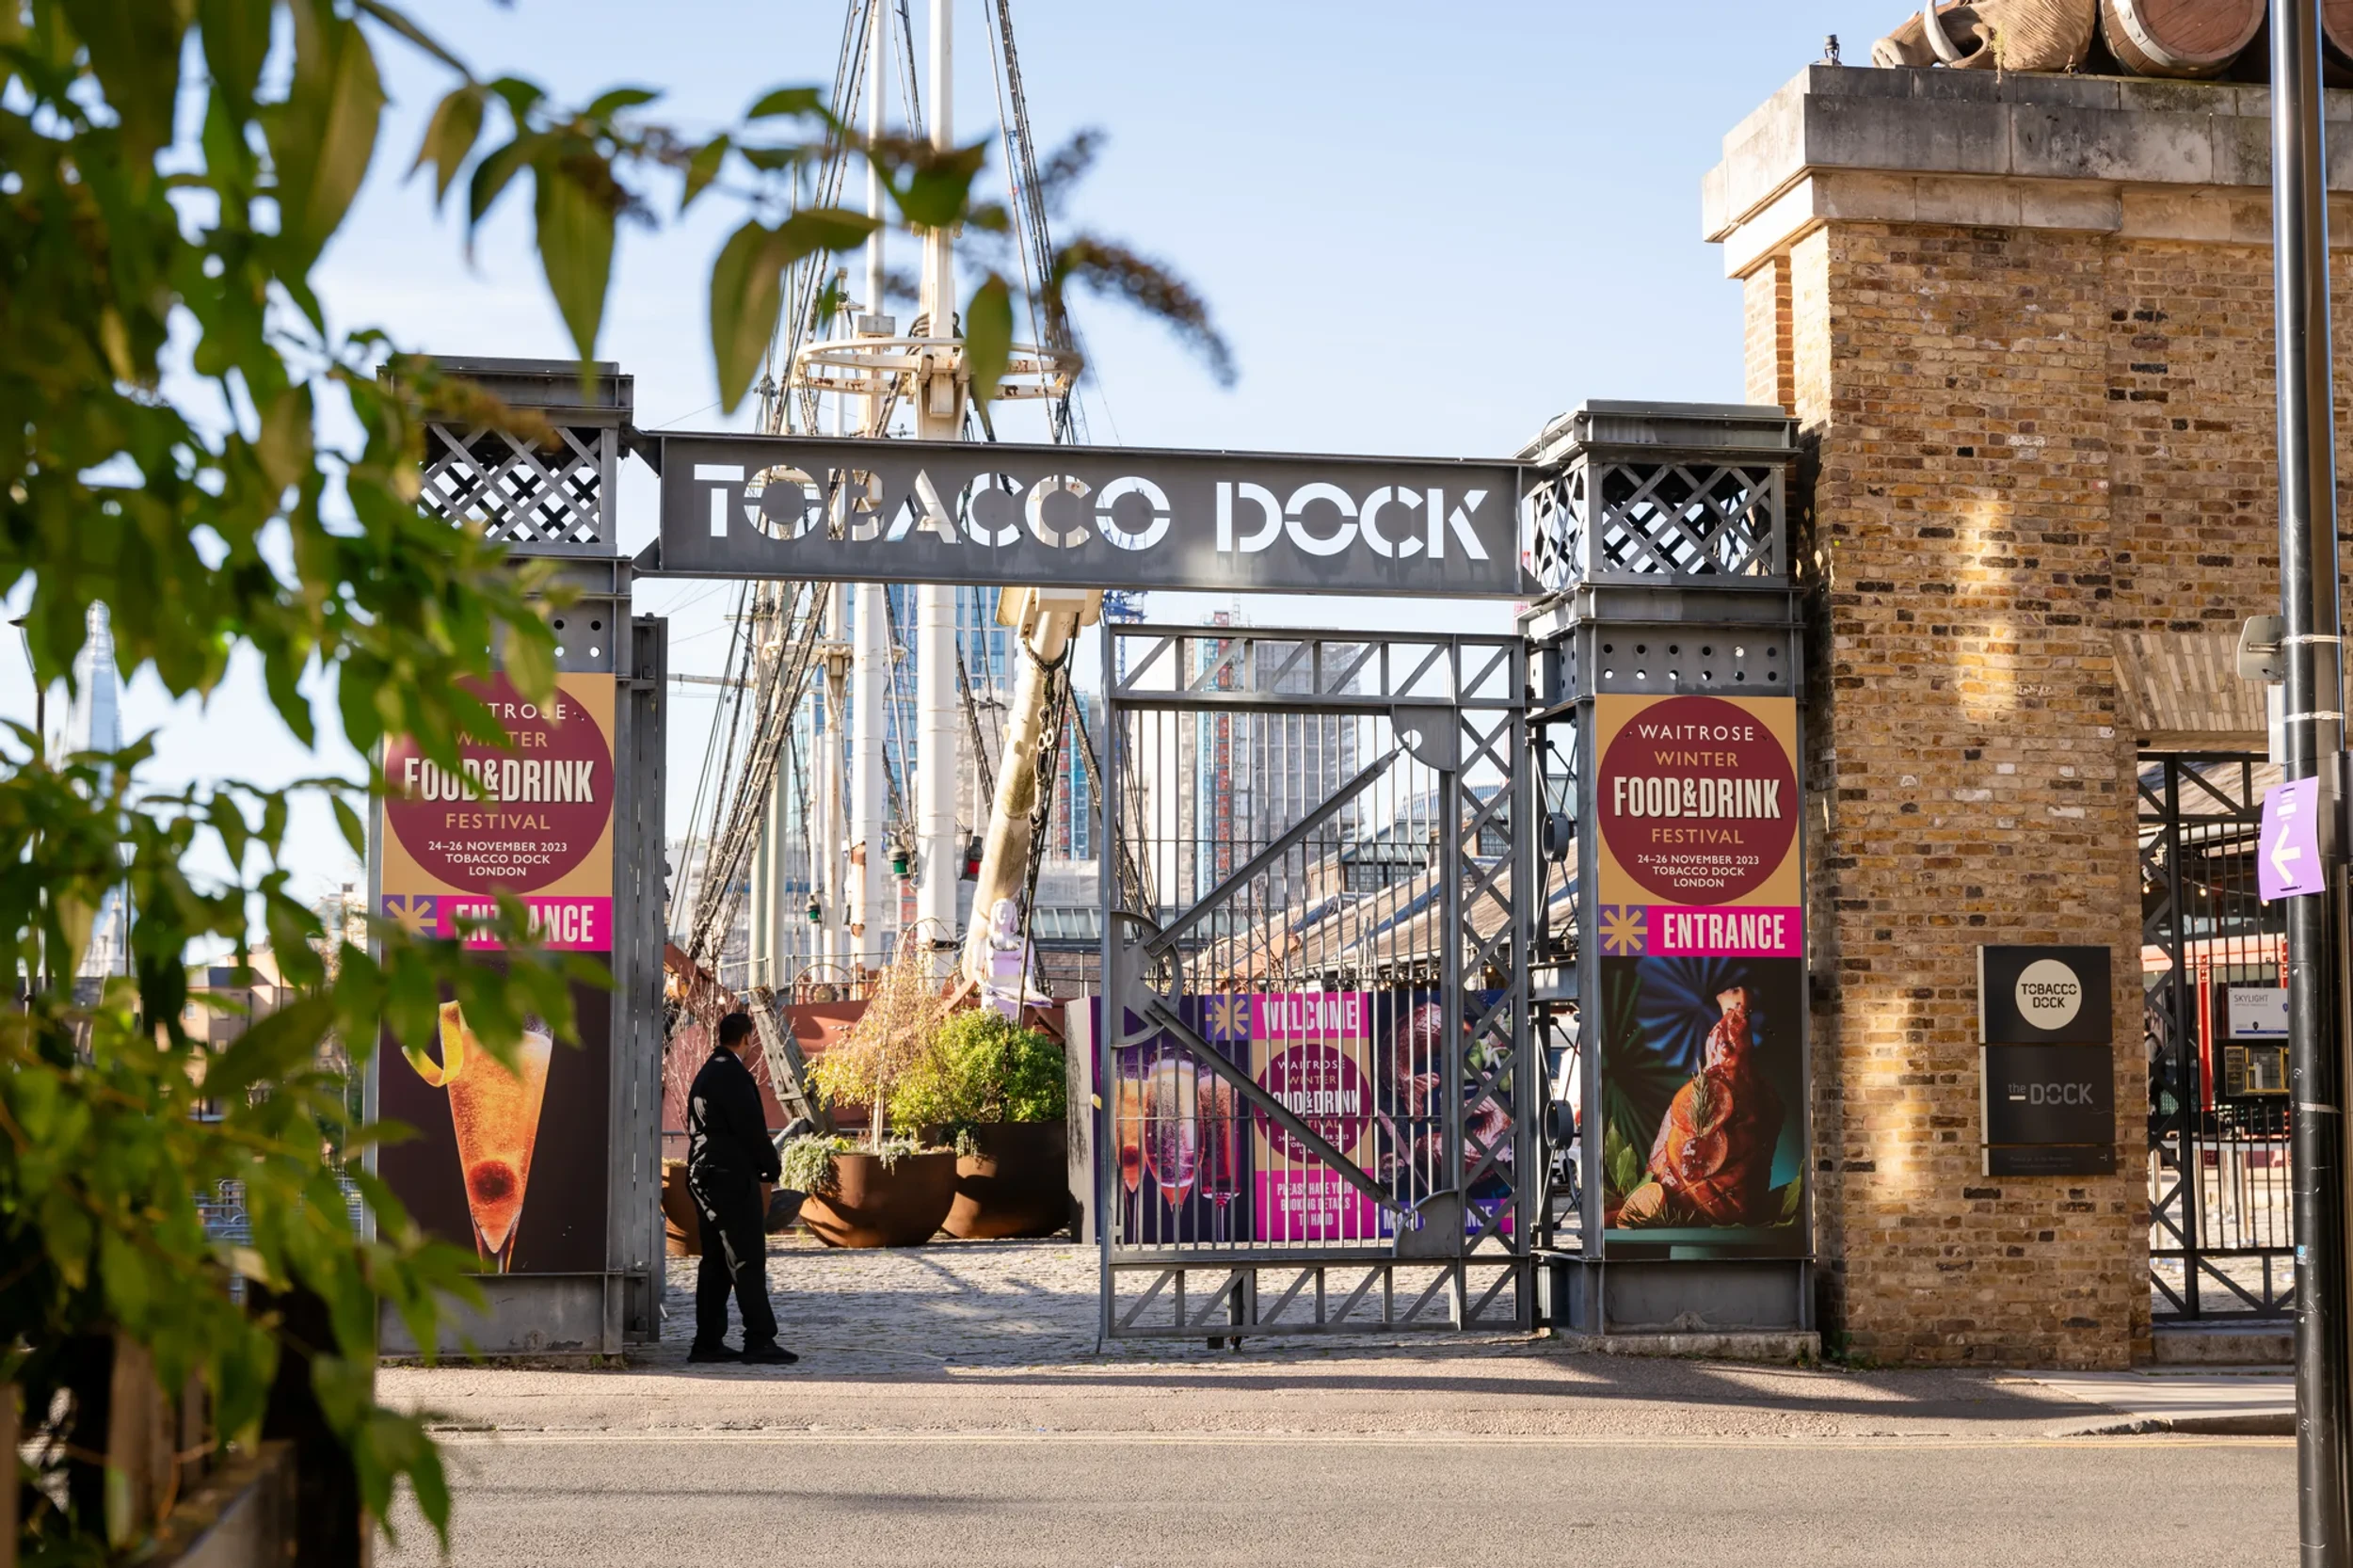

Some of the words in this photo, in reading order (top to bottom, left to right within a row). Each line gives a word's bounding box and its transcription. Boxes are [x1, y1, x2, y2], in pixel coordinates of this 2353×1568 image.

[695, 463, 1171, 552] TOBACCO
[1217, 481, 1489, 561] DOCK
[478, 702, 567, 720] TROE
[455, 730, 548, 747] WTER
[1639, 724, 1753, 742] WAITROSE
[1654, 751, 1738, 767] WINTER
[1613, 776, 1781, 819] FOOD&DRINK
[445, 813, 551, 830] FESTIVAL
[1652, 828, 1744, 844] FESTIVAL
[467, 841, 536, 852] NOVEMBER
[540, 841, 568, 852] 2023
[445, 854, 510, 864] TOBACCO
[513, 855, 551, 865] DOCK
[1671, 855, 1732, 865] NOVEMBER
[1736, 856, 1759, 865] 2023
[469, 866, 526, 876] LONDON
[1653, 866, 1708, 876] TOBACCO
[1712, 867, 1745, 876] DOCK
[1673, 877, 1724, 888] LONDON
[456, 904, 594, 943] ENTANCE
[1663, 913, 1785, 950] ENTRANCE
[2021, 984, 2077, 995] TOBACCO
[2033, 997, 2065, 1008] DOCK
[2233, 994, 2269, 1002] SKYLIGHT
[2008, 1082, 2026, 1094] the
[2030, 1082, 2093, 1105] DOCK
